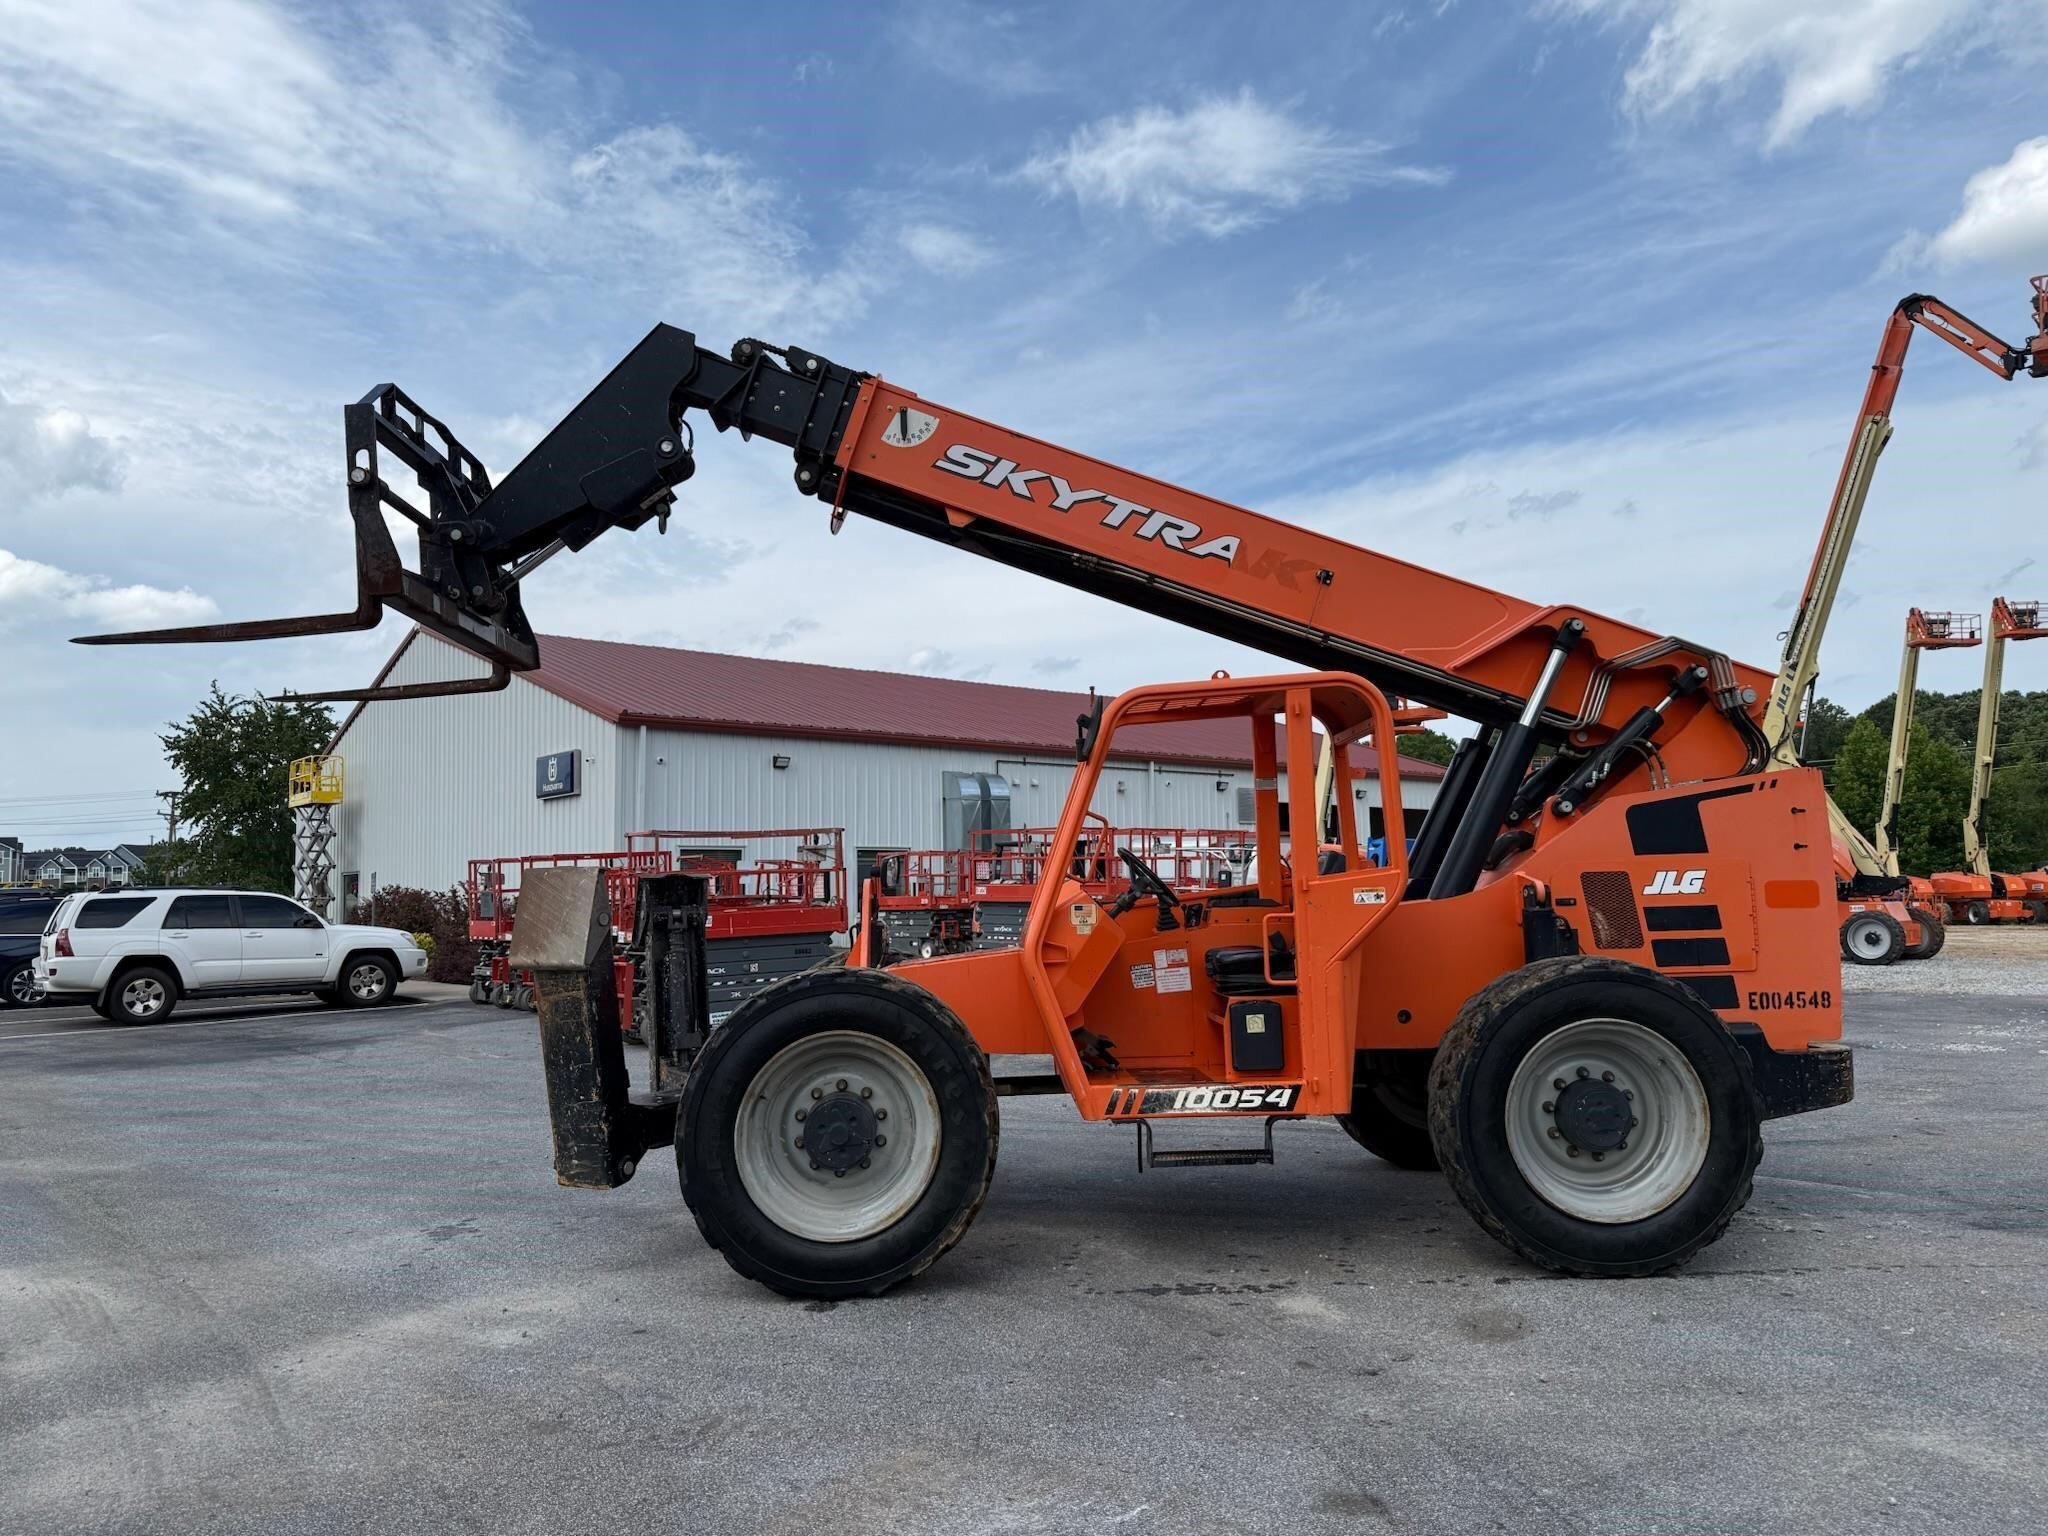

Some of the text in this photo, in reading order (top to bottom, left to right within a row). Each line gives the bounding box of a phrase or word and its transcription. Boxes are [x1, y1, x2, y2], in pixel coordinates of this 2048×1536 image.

[1642, 869, 1708, 895] JLG
[1747, 991, 1832, 1010] E004548
[1172, 1088, 1293, 1110] 10054
